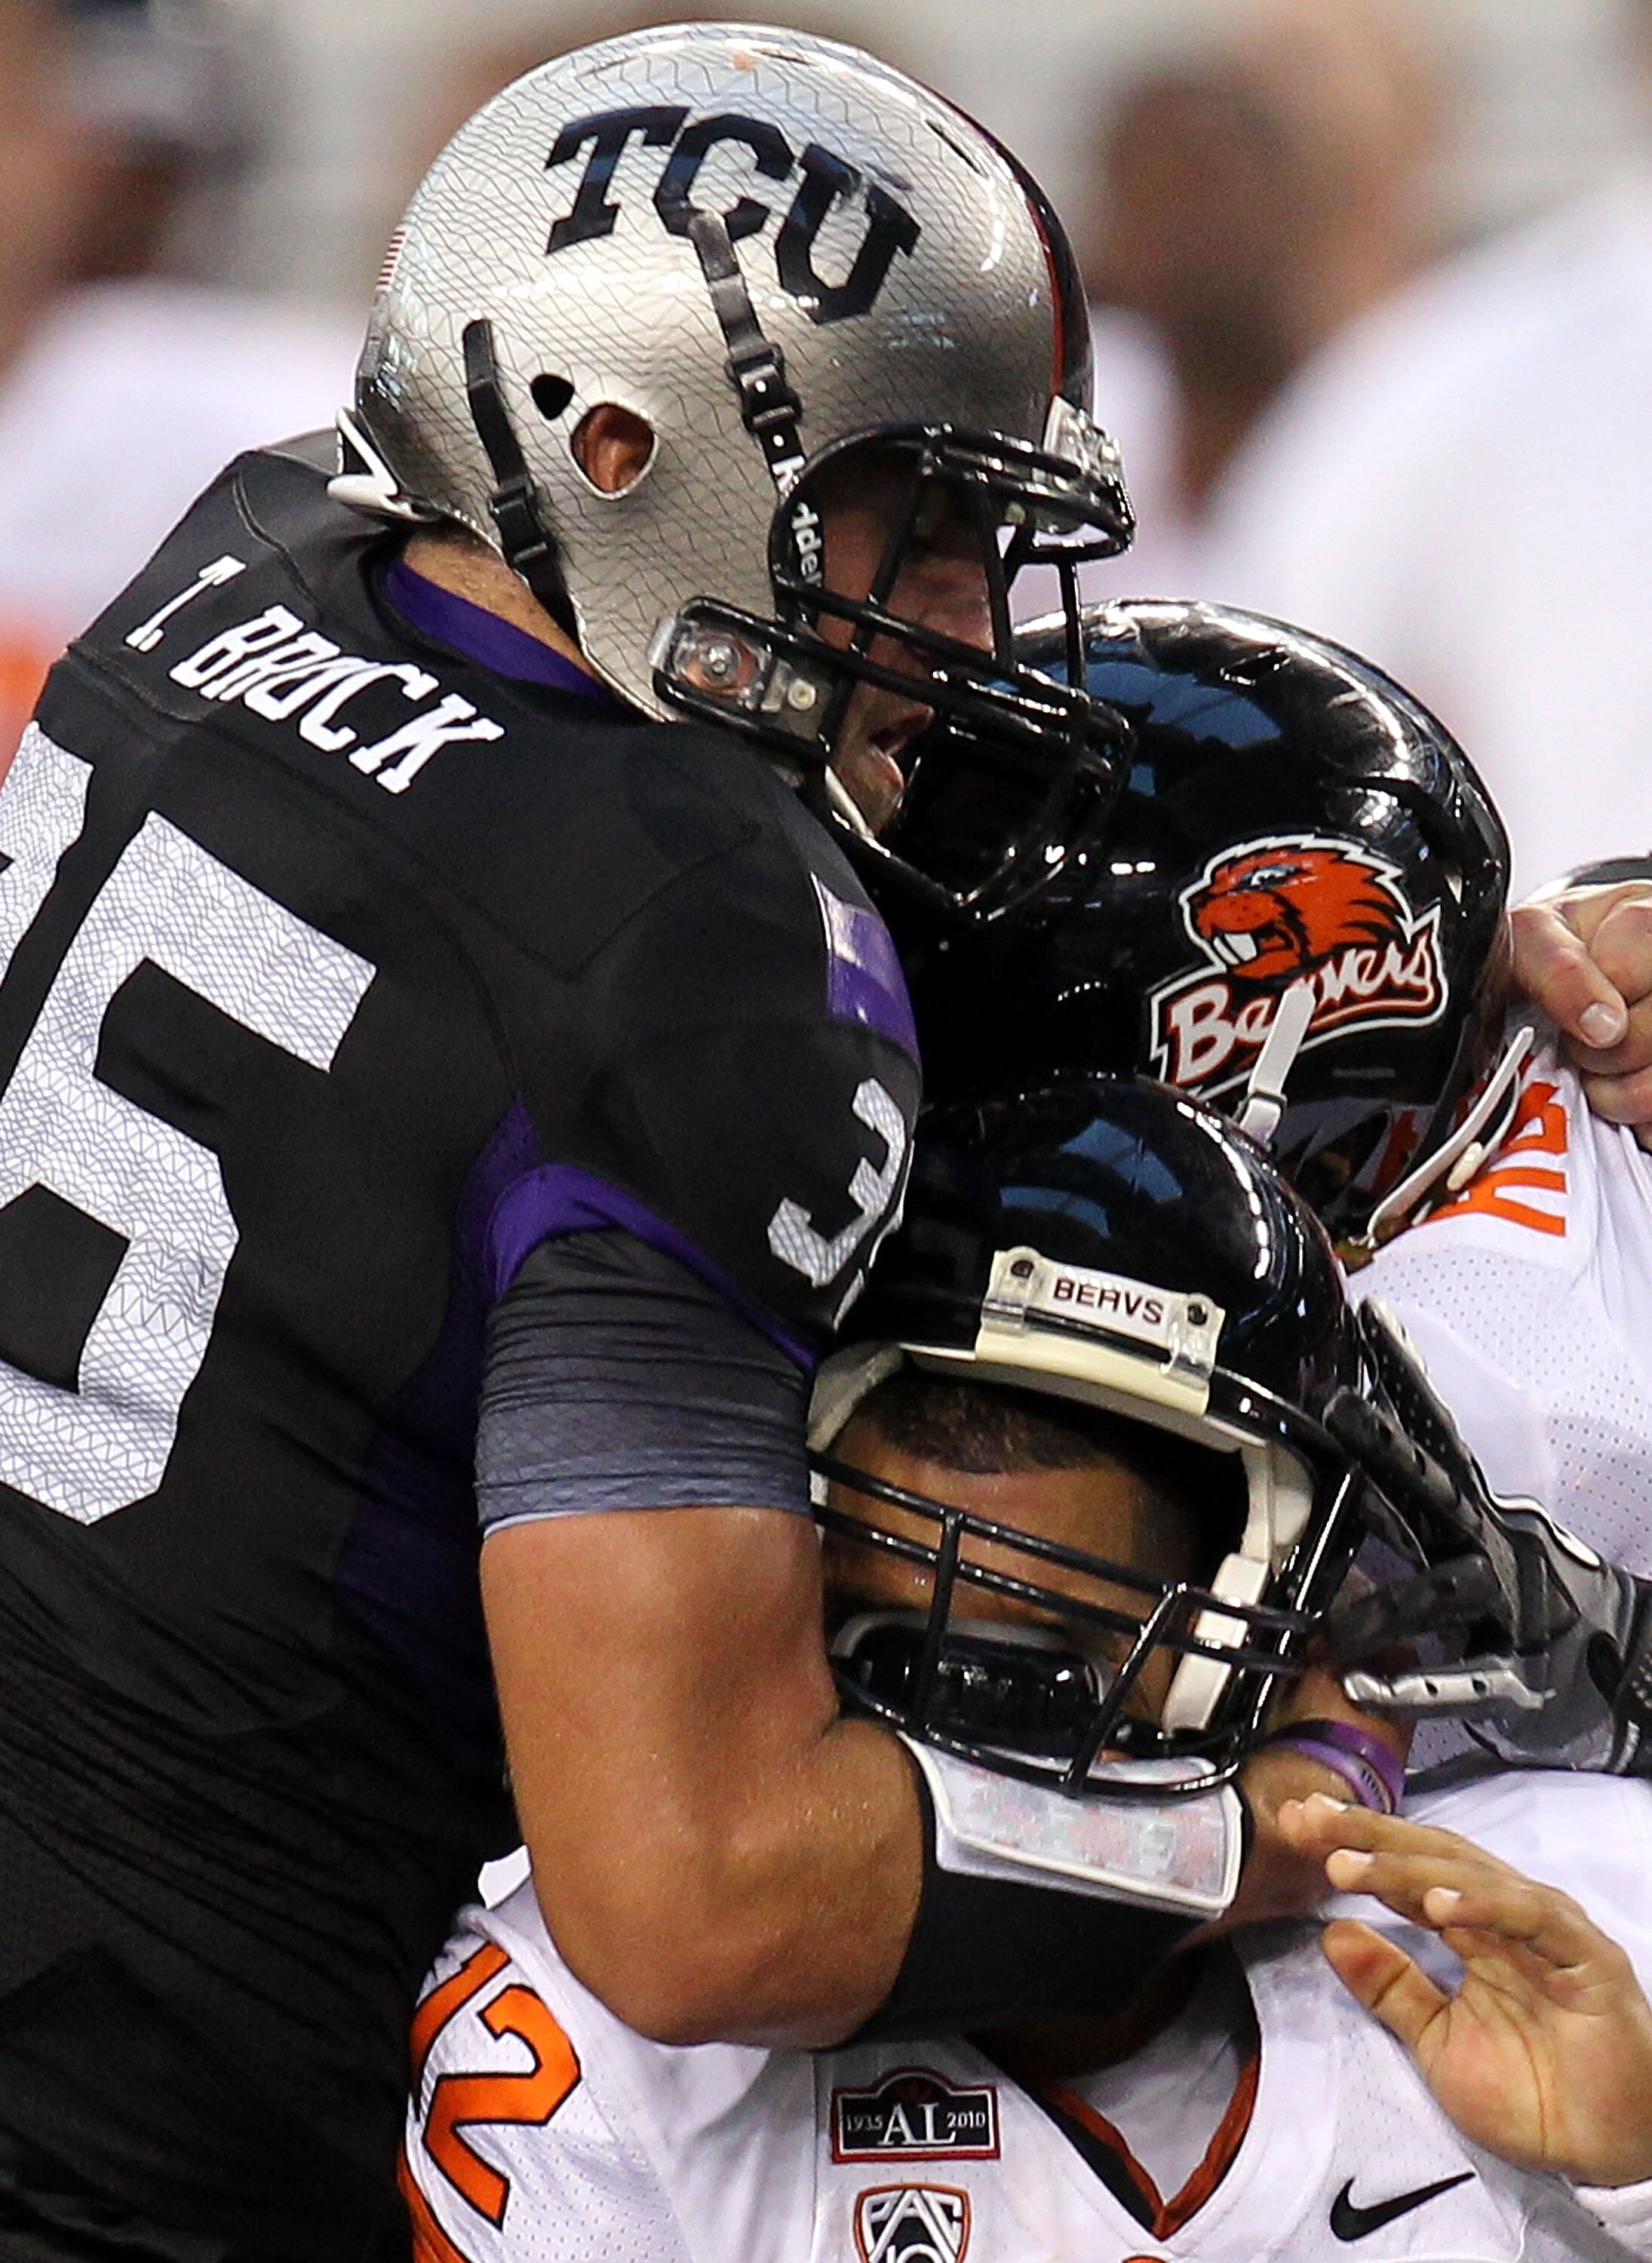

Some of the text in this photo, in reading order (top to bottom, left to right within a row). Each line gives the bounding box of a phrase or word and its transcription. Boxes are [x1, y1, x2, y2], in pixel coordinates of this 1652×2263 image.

[543, 105, 923, 325] TCU
[168, 604, 506, 794] BROCK
[1166, 932, 1435, 1084] Bevers
[0, 720, 378, 1526] 5
[766, 1077, 916, 1331] 3
[407, 1937, 582, 2233] 12
[877, 2102, 957, 2146] AL
[947, 2111, 986, 2129] 2010
